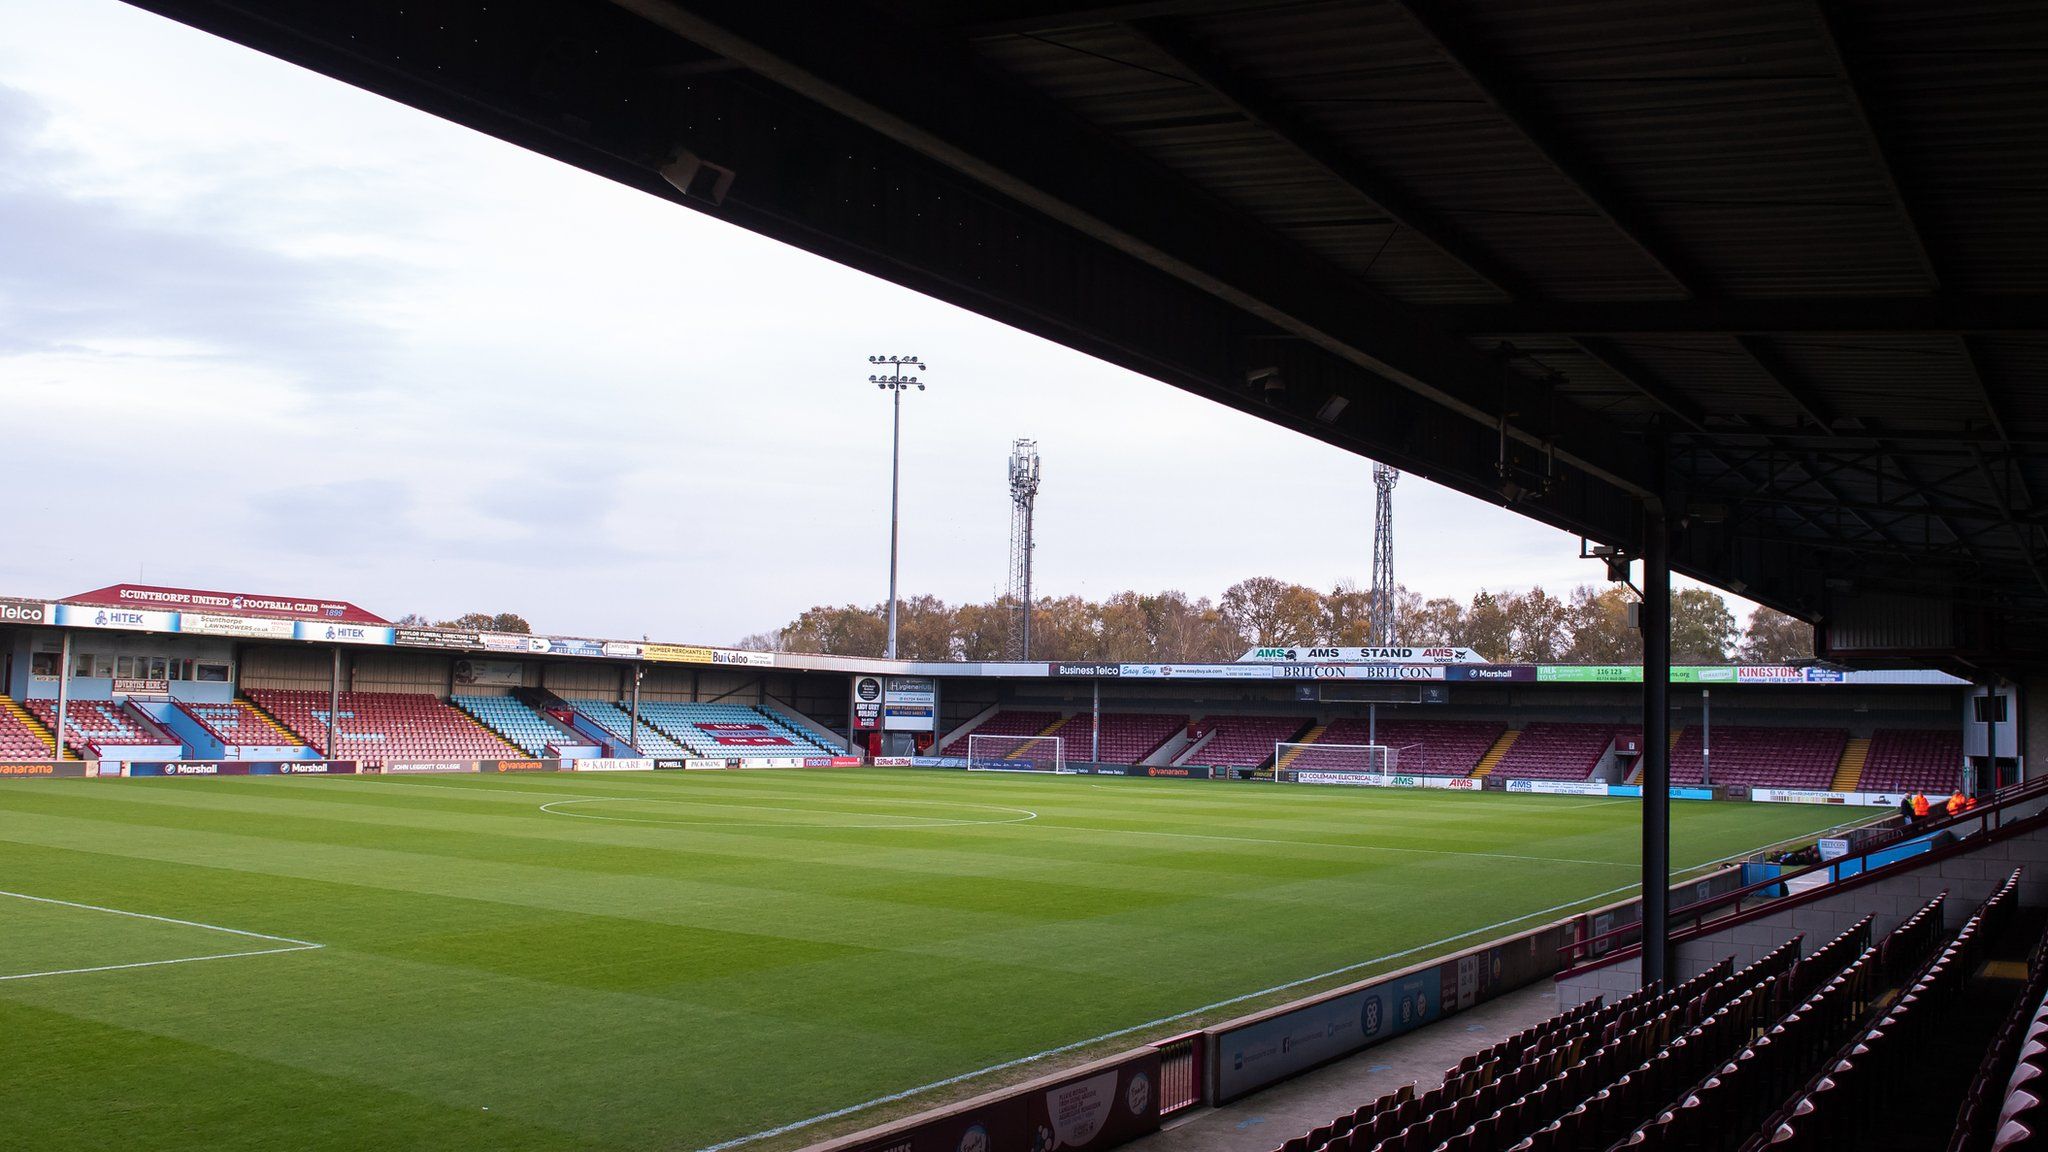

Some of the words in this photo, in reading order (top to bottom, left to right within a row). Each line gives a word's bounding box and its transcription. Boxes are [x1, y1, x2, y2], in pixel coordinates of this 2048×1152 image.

[120, 590, 190, 603] SCUNTHORPE
[192, 596, 230, 606] UNITED
[243, 600, 293, 611] FOOTBALL
[295, 603, 318, 612] CLUB
[0, 605, 42, 621] Telco
[111, 613, 144, 624] HITEK
[201, 616, 243, 624] Scunthorpe
[338, 628, 364, 638] HITEK
[1256, 649, 1284, 657] AMS
[1308, 649, 1339, 657] AMS
[1360, 649, 1413, 657] STAND
[1422, 649, 1453, 657] AMS
[1060, 666, 1094, 675] Business
[1096, 666, 1118, 675] Telco
[1122, 666, 1140, 676] Easy
[1142, 666, 1157, 676] Buy
[1284, 666, 1346, 677] BRITCON
[1367, 667, 1432, 678] BRITCON
[1480, 670, 1512, 678] Marshall
[1739, 667, 1804, 677] KINGSTONS
[114, 680, 145, 689] ADVERTISE
[146, 681, 161, 689] HERE
[592, 760, 617, 769] KAPIL
[619, 760, 641, 769] CARE
[876, 757, 893, 765] 32Red
[895, 757, 911, 765] 32Red
[178, 764, 218, 773] Marshall
[292, 764, 328, 772] Marshall
[1391, 777, 1414, 785] AMS
[1449, 778, 1473, 788] AMS
